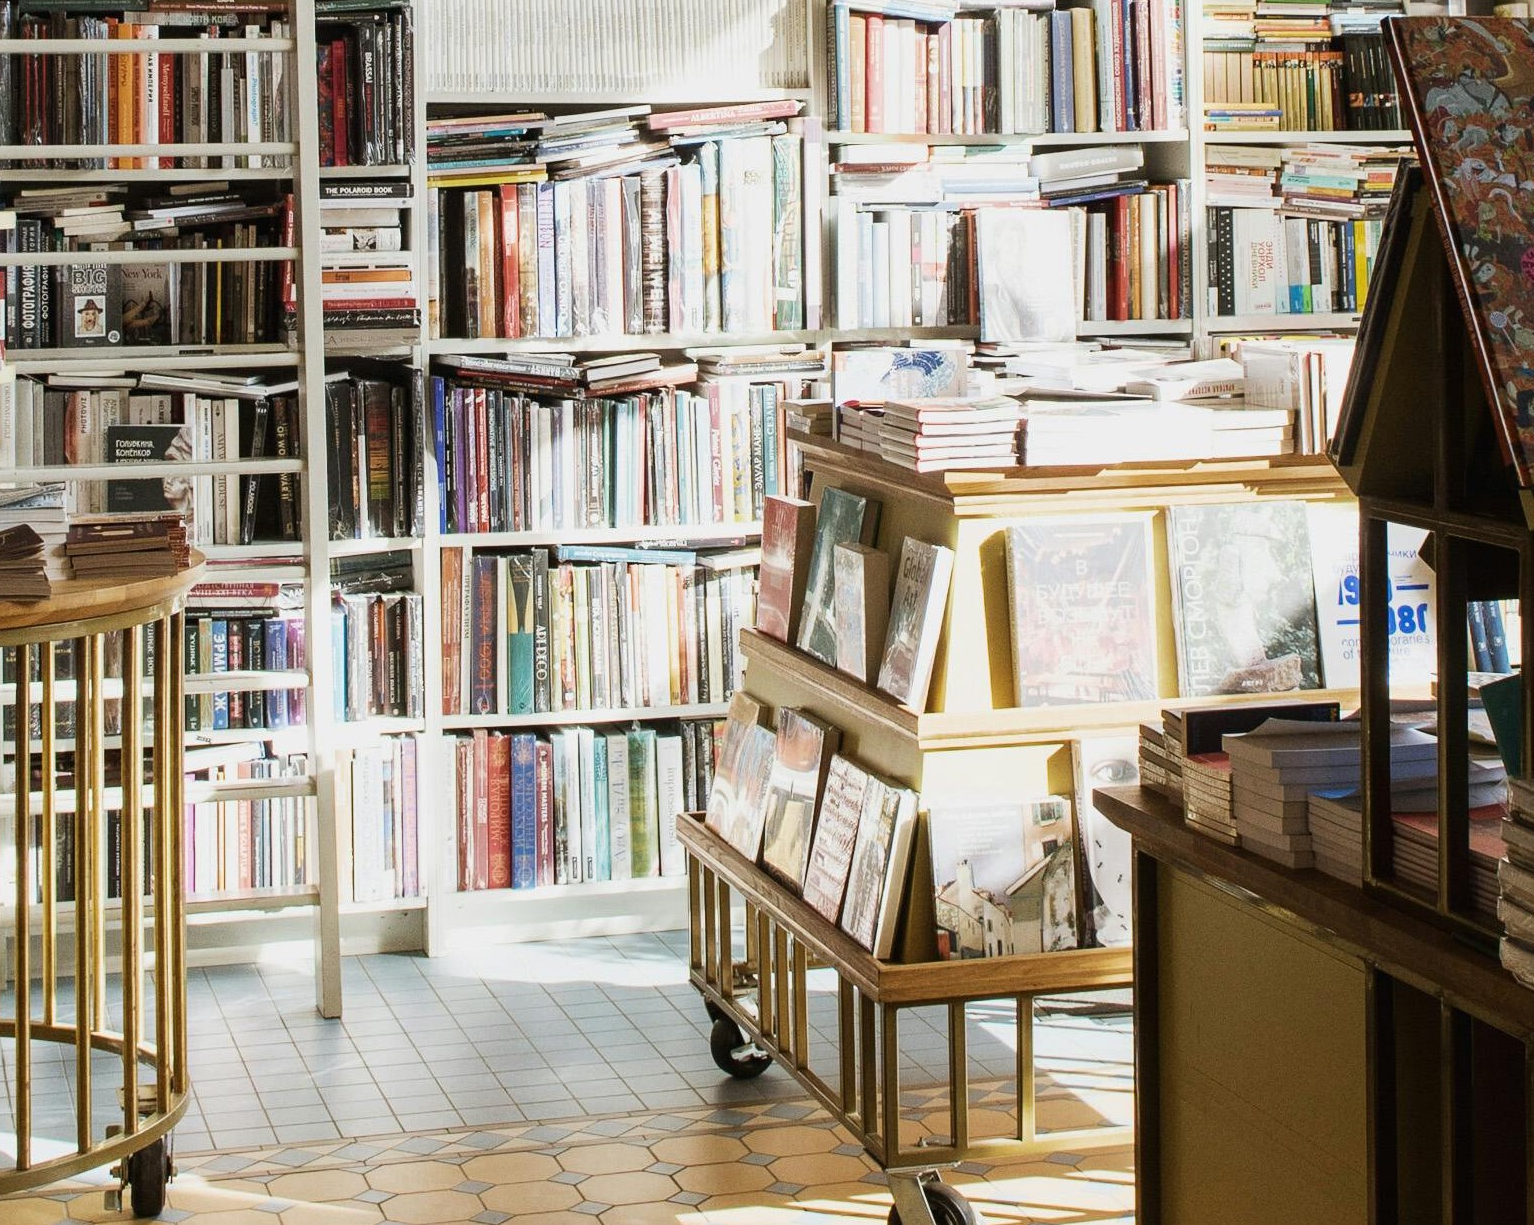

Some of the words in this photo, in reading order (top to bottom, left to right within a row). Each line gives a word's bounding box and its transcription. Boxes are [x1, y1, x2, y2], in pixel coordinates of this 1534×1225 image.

[690, 110, 736, 125] ALBERTINA
[324, 186, 339, 195] THE
[340, 186, 372, 195] POLAROID
[374, 187, 394, 196] BOOK
[1266, 240, 1275, 270] ЭНДИ
[72, 270, 107, 285] BIG
[141, 267, 164, 280] York
